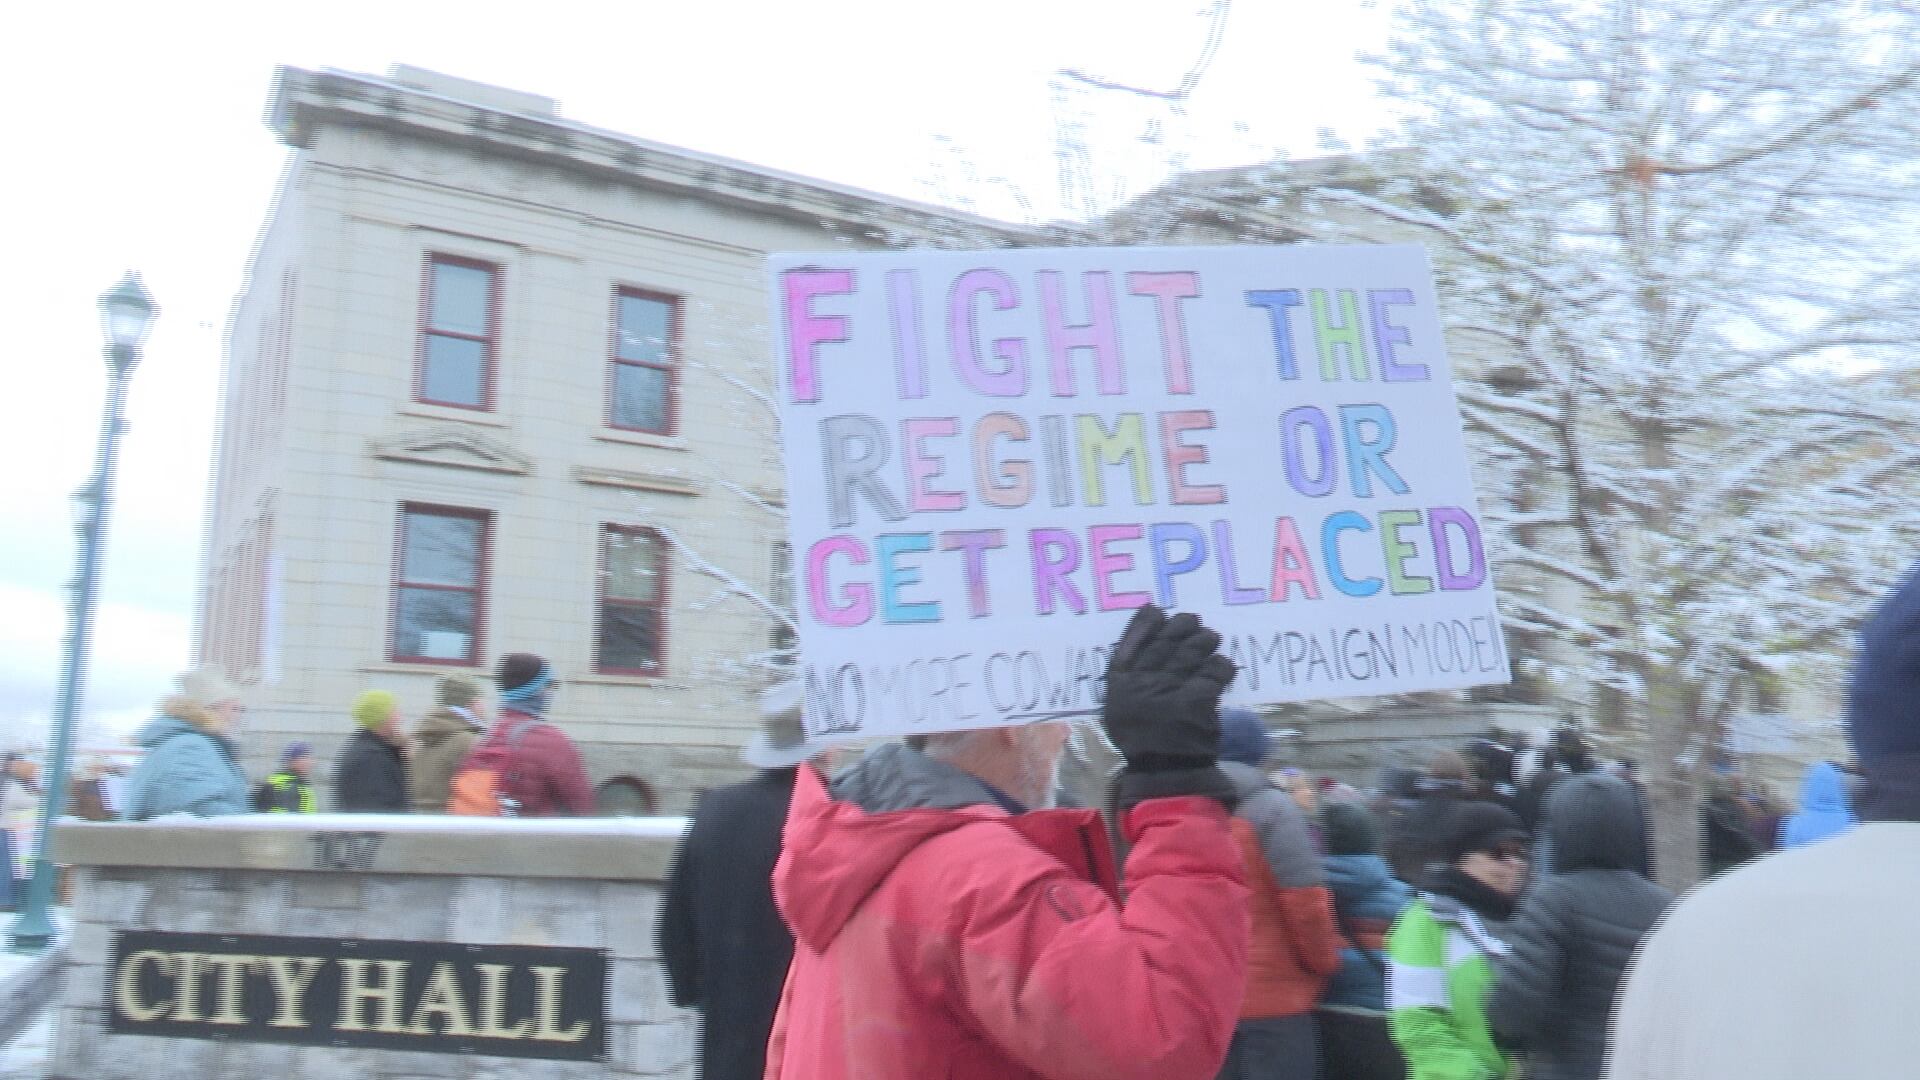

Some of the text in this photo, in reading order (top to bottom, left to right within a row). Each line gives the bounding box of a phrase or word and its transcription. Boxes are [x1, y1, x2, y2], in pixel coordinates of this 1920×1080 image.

[780, 265, 1431, 404] FIGHT THE
[818, 403, 1412, 529] REGIME OR
[805, 506, 1487, 627] GET REPLACED
[803, 661, 866, 736] NO
[868, 652, 980, 726] MORE
[1222, 622, 1398, 692] AMPAIGN
[305, 830, 386, 871] 107
[112, 949, 593, 1043] CITY HALL
